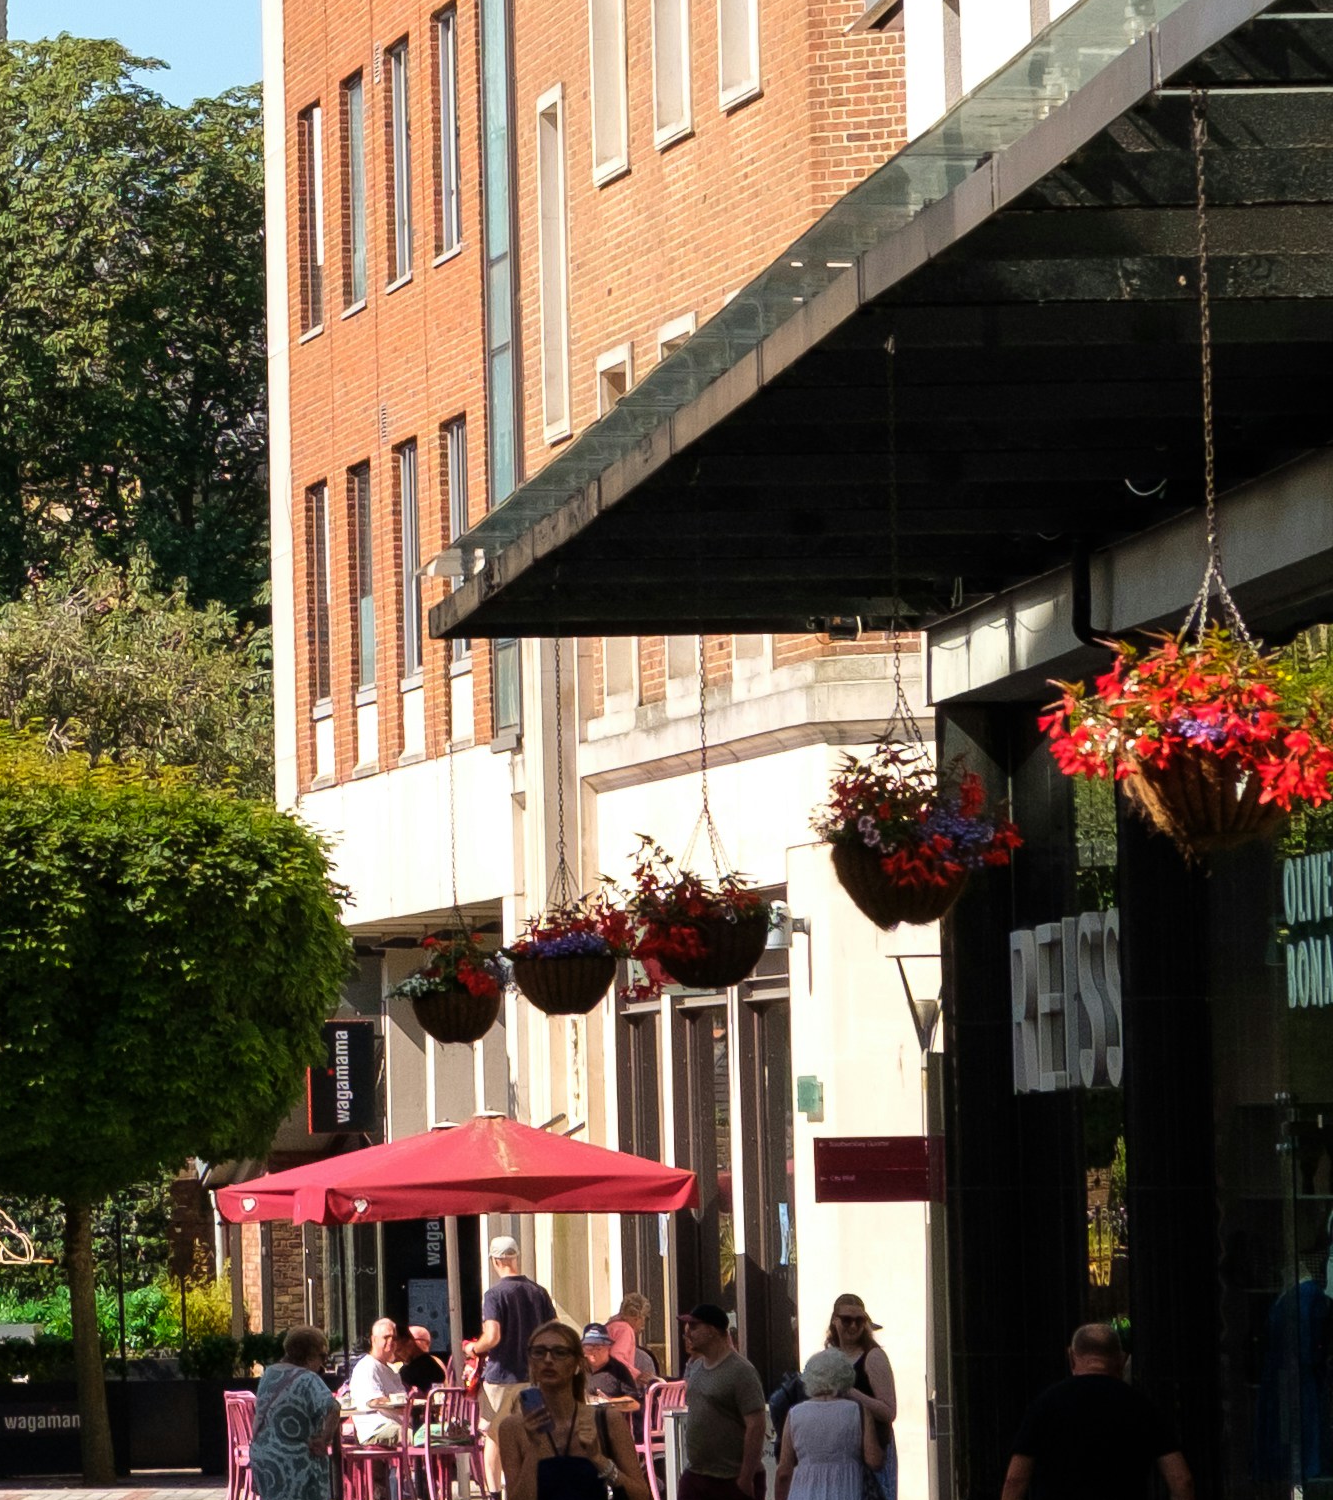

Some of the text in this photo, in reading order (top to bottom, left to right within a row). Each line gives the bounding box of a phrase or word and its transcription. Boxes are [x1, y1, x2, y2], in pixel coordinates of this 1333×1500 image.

[1283, 851, 1333, 925] OLIVE
[1009, 907, 1123, 1095] REISS
[1286, 934, 1333, 1008] BONA
[335, 1030, 353, 1123] wagamama
[426, 1217, 444, 1266] waga
[4, 1413, 81, 1432] wagamam
